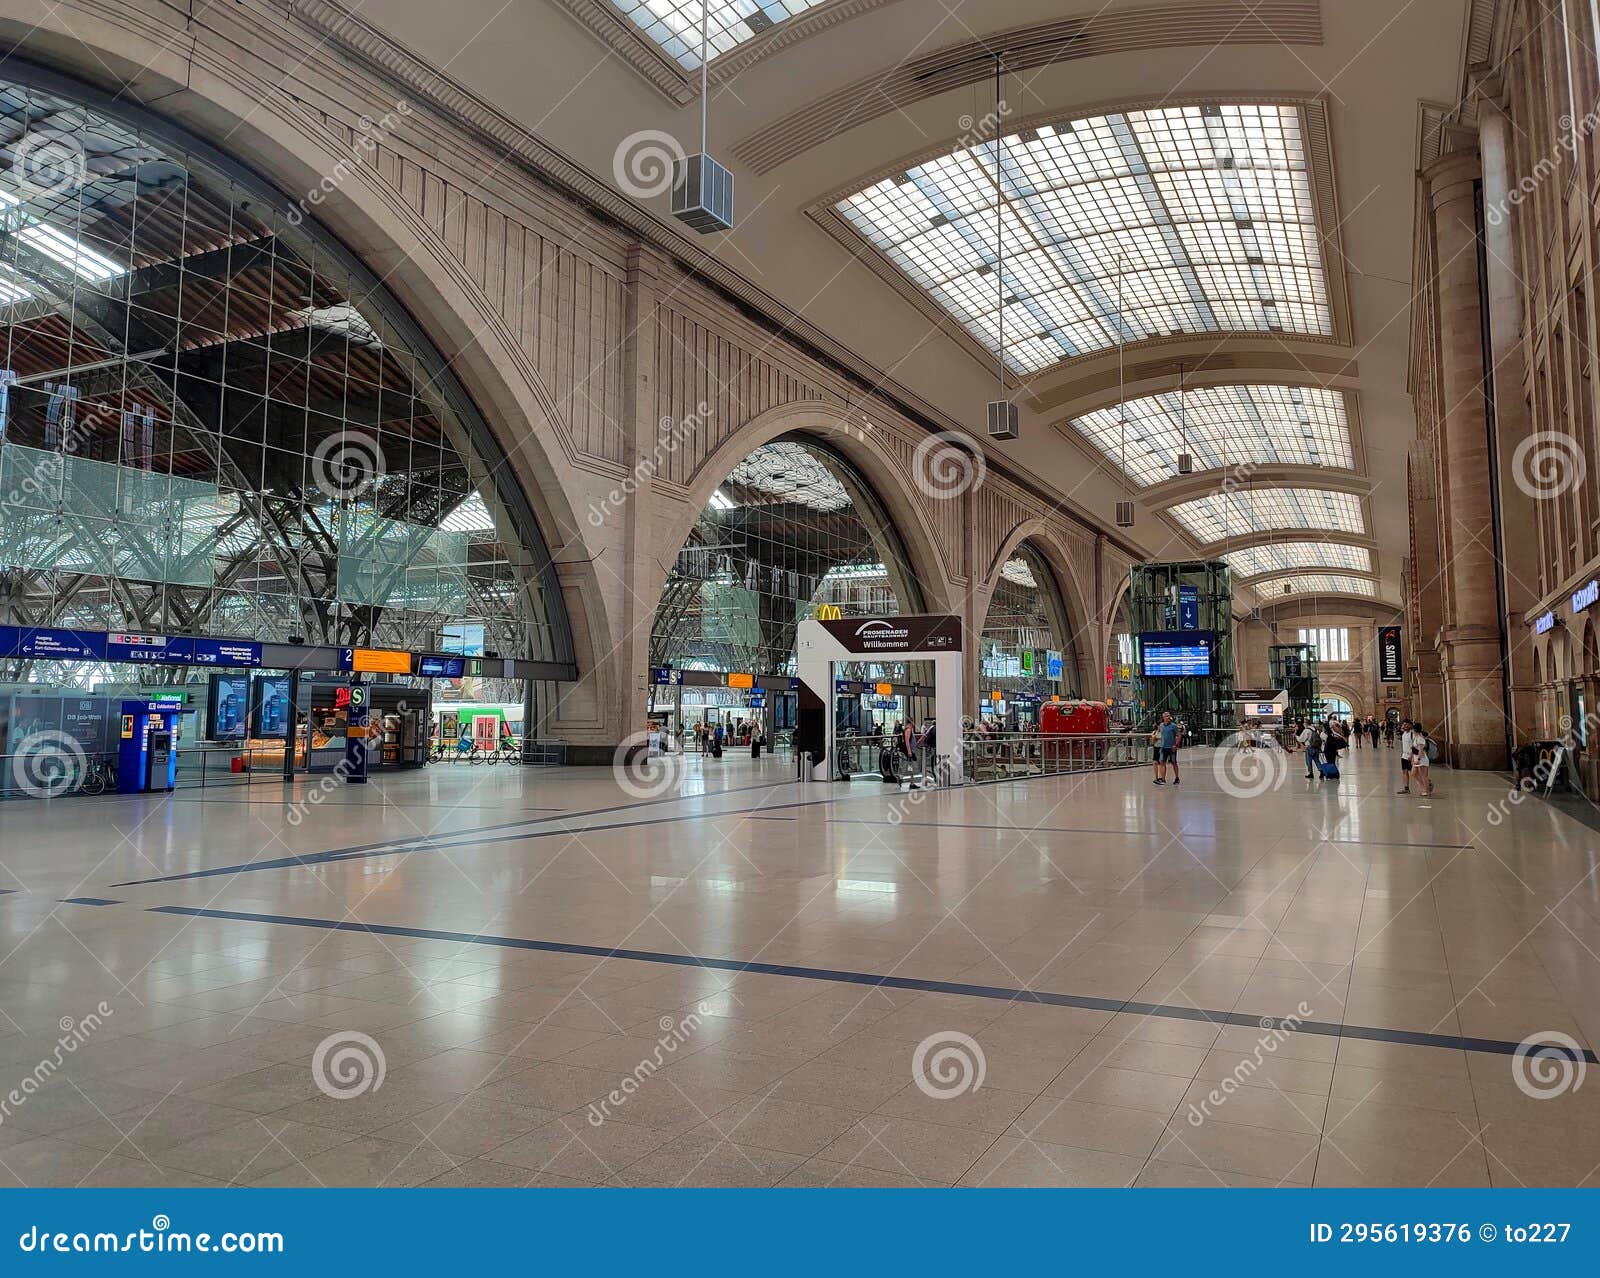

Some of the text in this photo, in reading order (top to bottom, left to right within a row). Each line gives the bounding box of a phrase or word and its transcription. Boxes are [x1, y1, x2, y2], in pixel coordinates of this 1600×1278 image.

[863, 641, 909, 649] Willkommen
[345, 649, 354, 661] 2
[1385, 644, 1397, 677] SATURN
